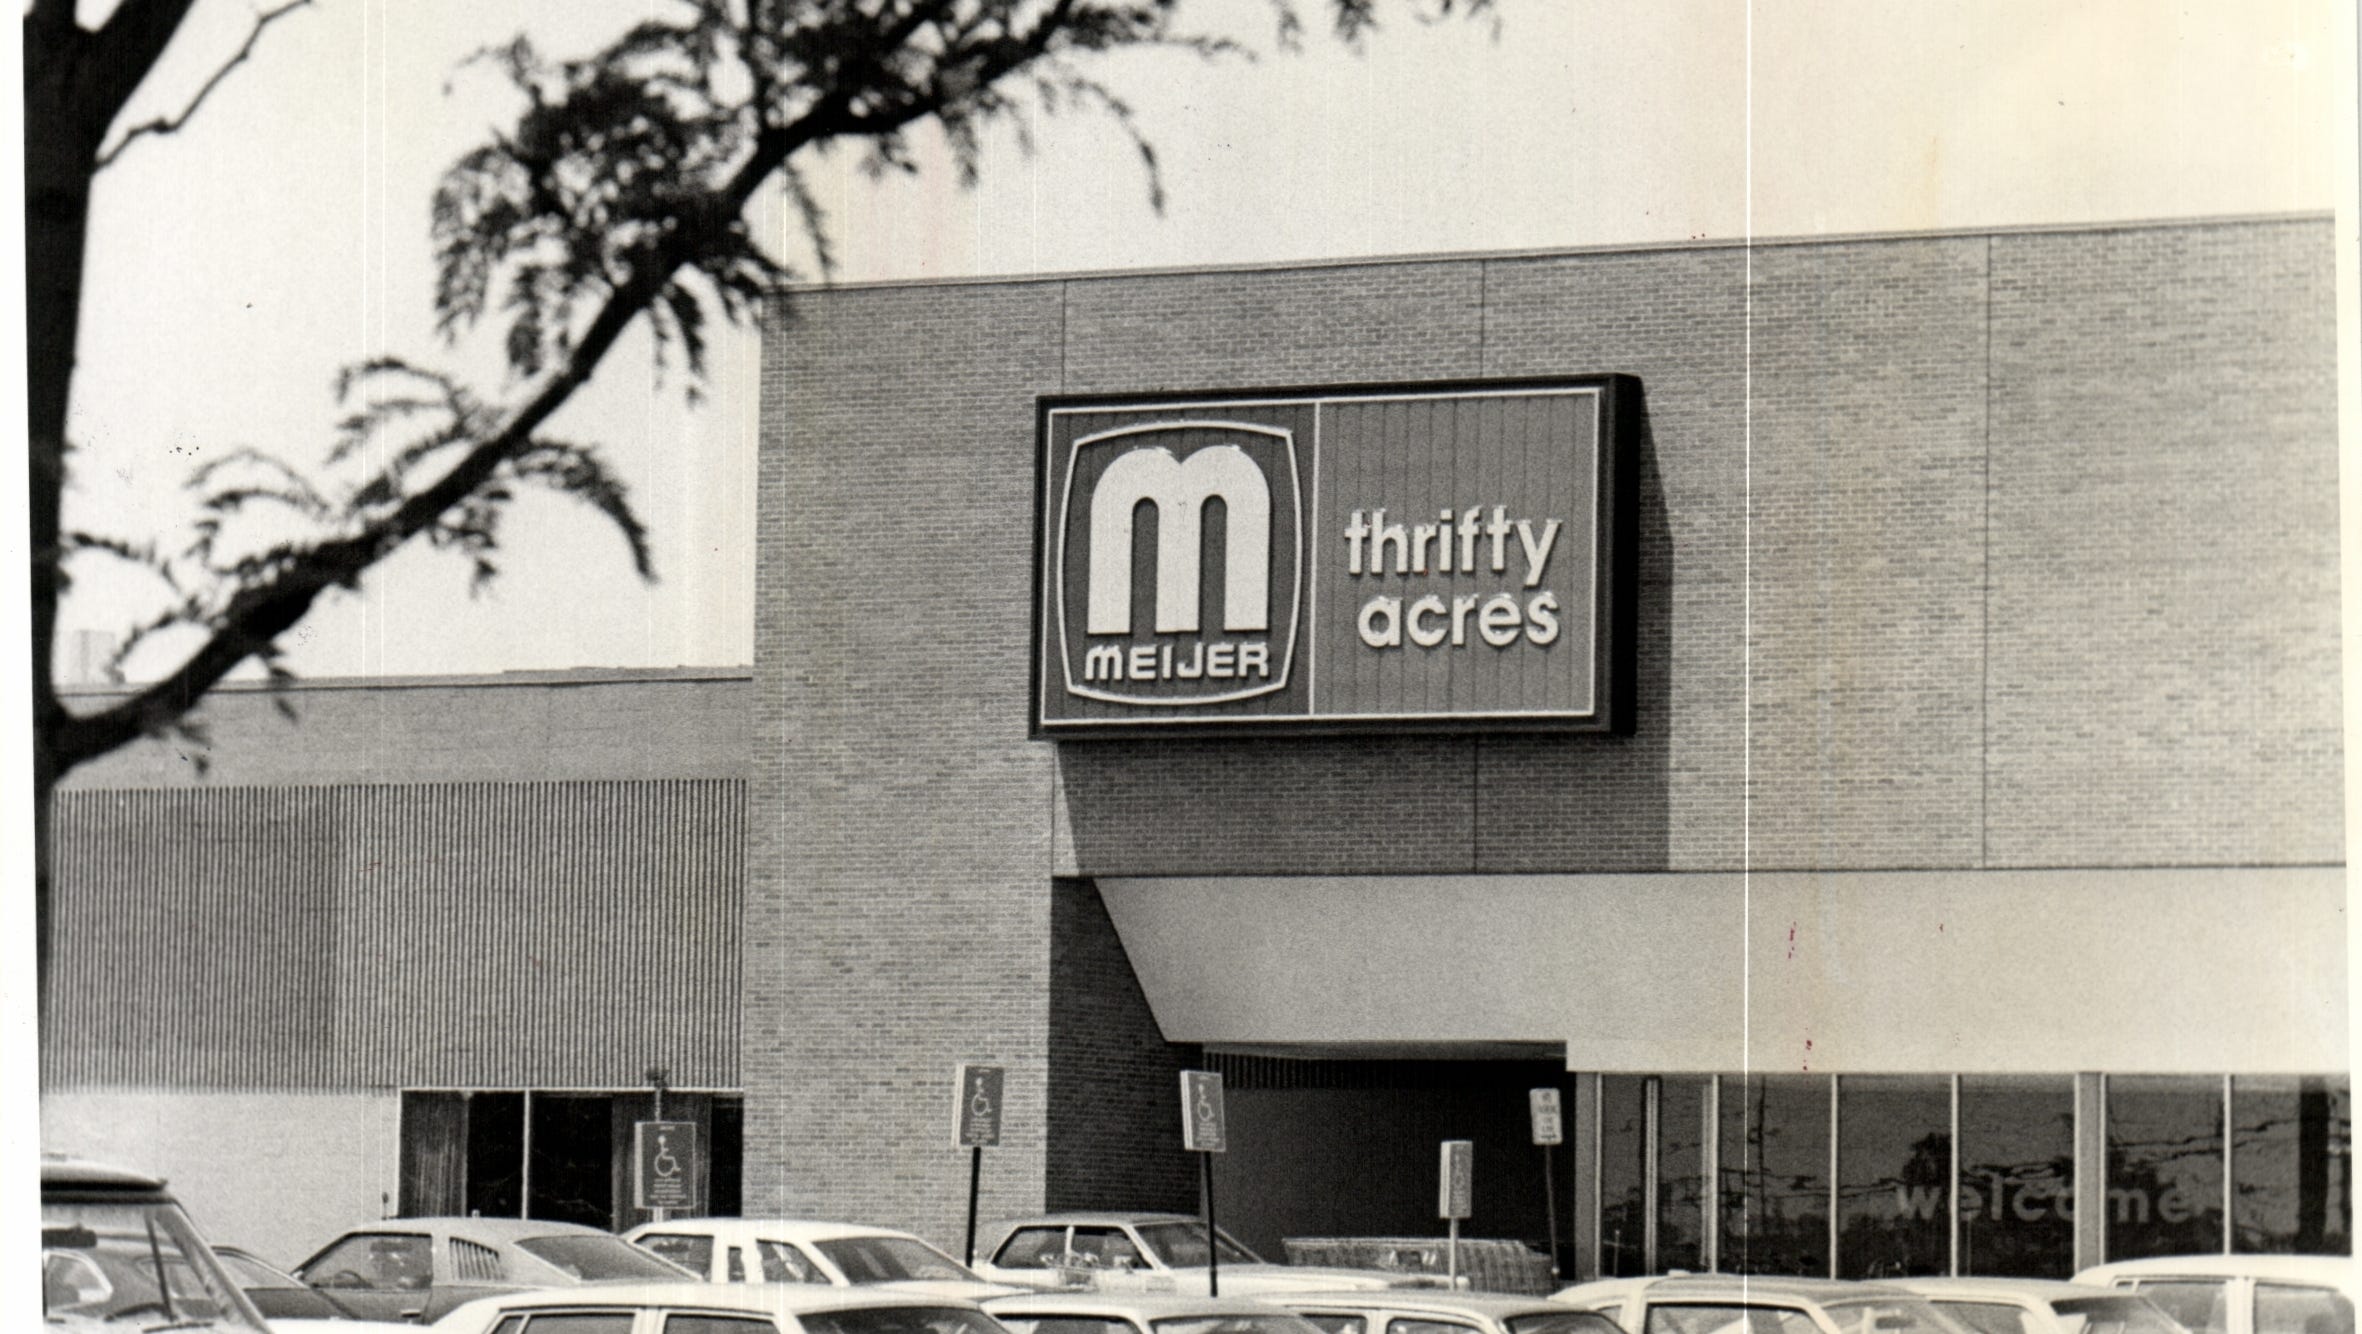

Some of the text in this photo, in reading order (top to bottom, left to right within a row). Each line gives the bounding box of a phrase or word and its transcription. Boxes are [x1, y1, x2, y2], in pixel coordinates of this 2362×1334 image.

[1345, 505, 1563, 587] thrifty
[1358, 591, 1559, 647] acres
[1085, 643, 1268, 680] MEIJER
